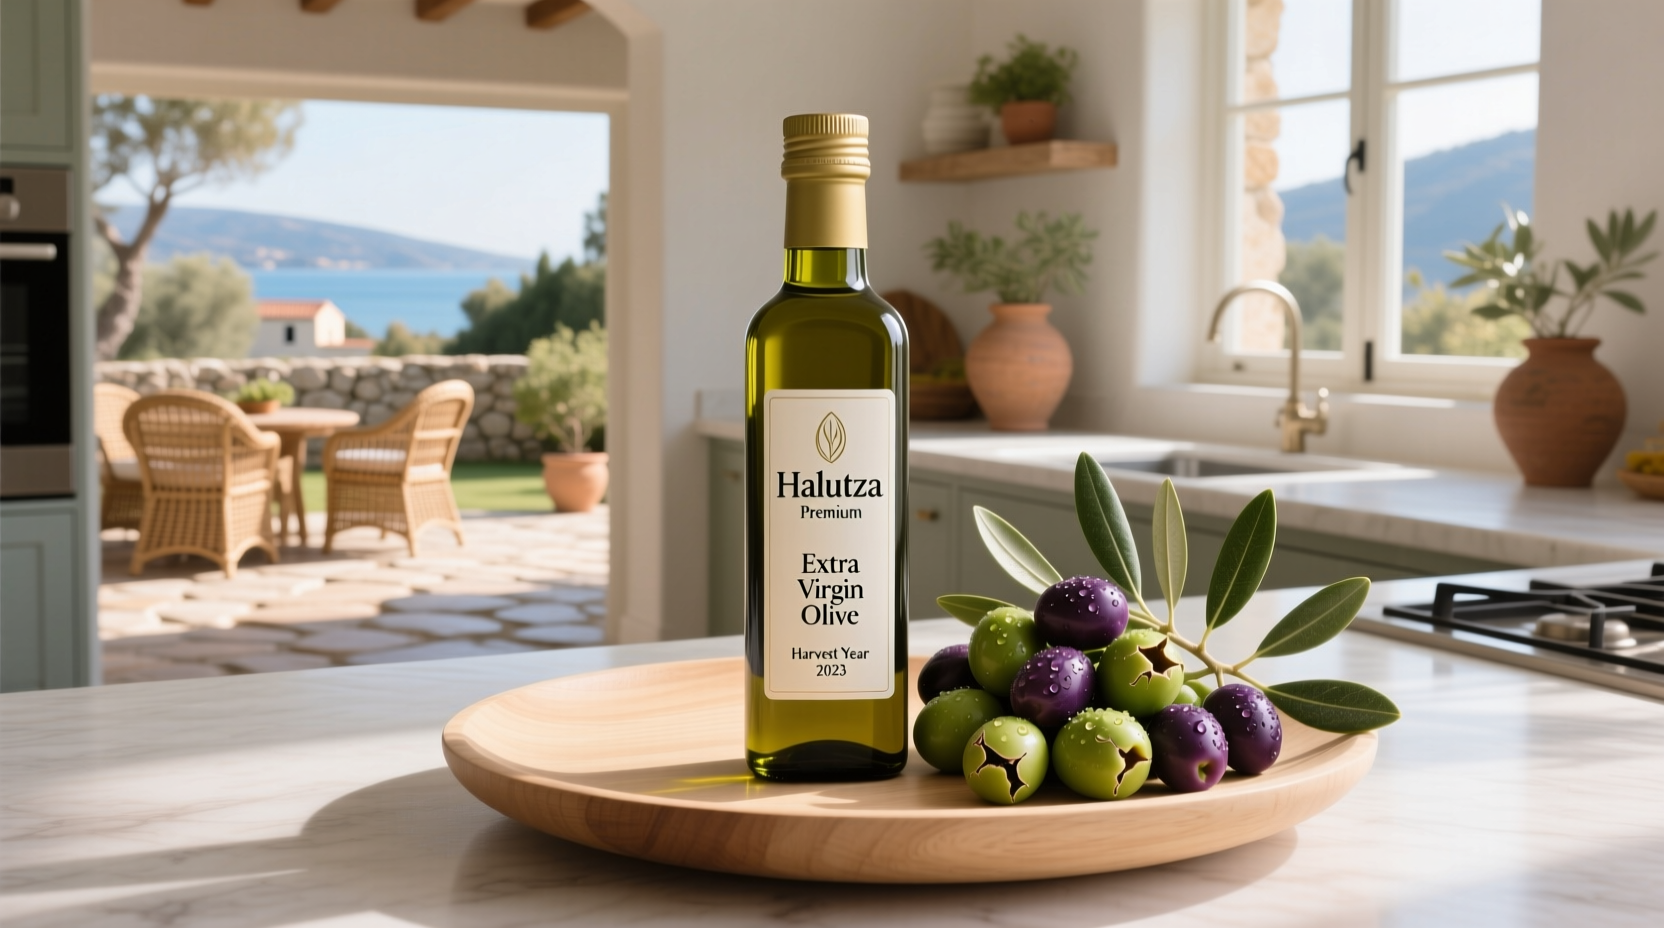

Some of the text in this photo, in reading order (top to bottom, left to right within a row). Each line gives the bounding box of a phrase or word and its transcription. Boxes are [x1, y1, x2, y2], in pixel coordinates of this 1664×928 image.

[776, 470, 884, 498] Halutza
[800, 505, 862, 519] Premium
[801, 553, 860, 574] Extra
[797, 578, 864, 605] Virgin
[801, 604, 859, 625] Olive
[791, 647, 870, 660] Harvest Year
[816, 664, 847, 677] 2023
